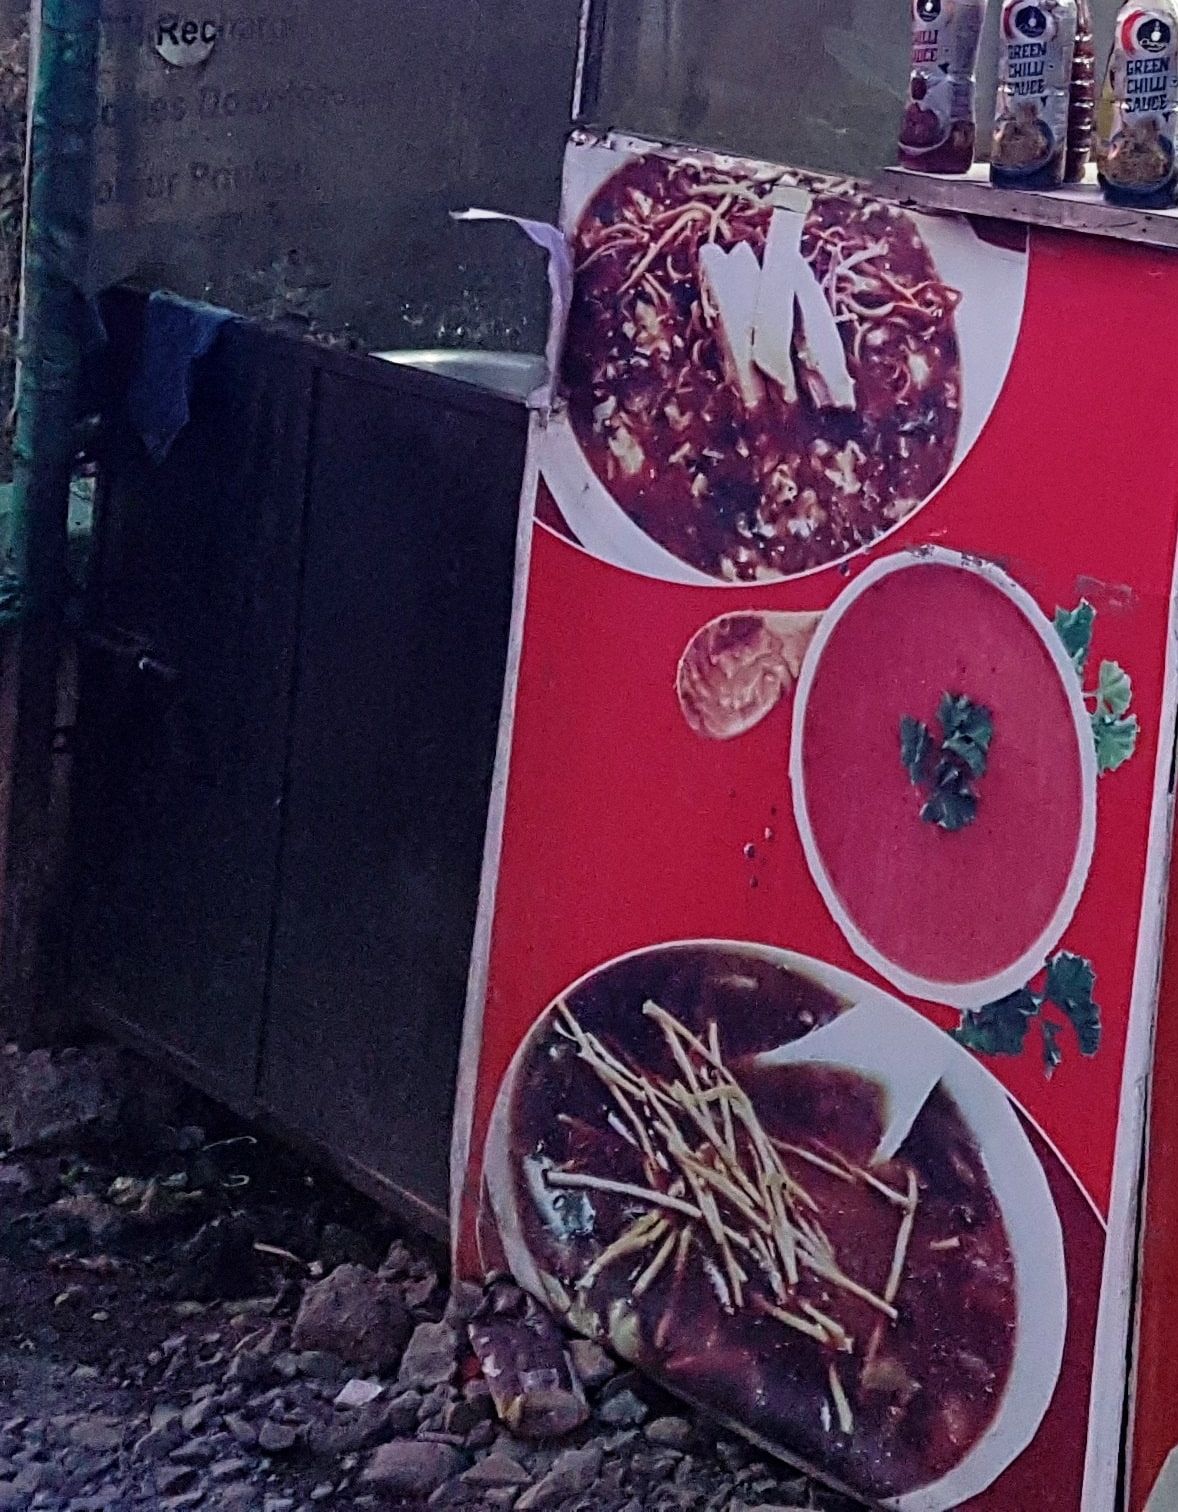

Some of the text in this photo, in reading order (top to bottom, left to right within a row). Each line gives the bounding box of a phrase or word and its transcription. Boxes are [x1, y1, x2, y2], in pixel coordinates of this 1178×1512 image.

[1007, 42, 1047, 60] GREEN
[1008, 60, 1045, 79] CHILLI
[1126, 56, 1171, 76] GREEN
[1006, 78, 1045, 97] SAUCE
[1126, 75, 1167, 95] CHILLI
[1125, 94, 1168, 113] SAUCE
